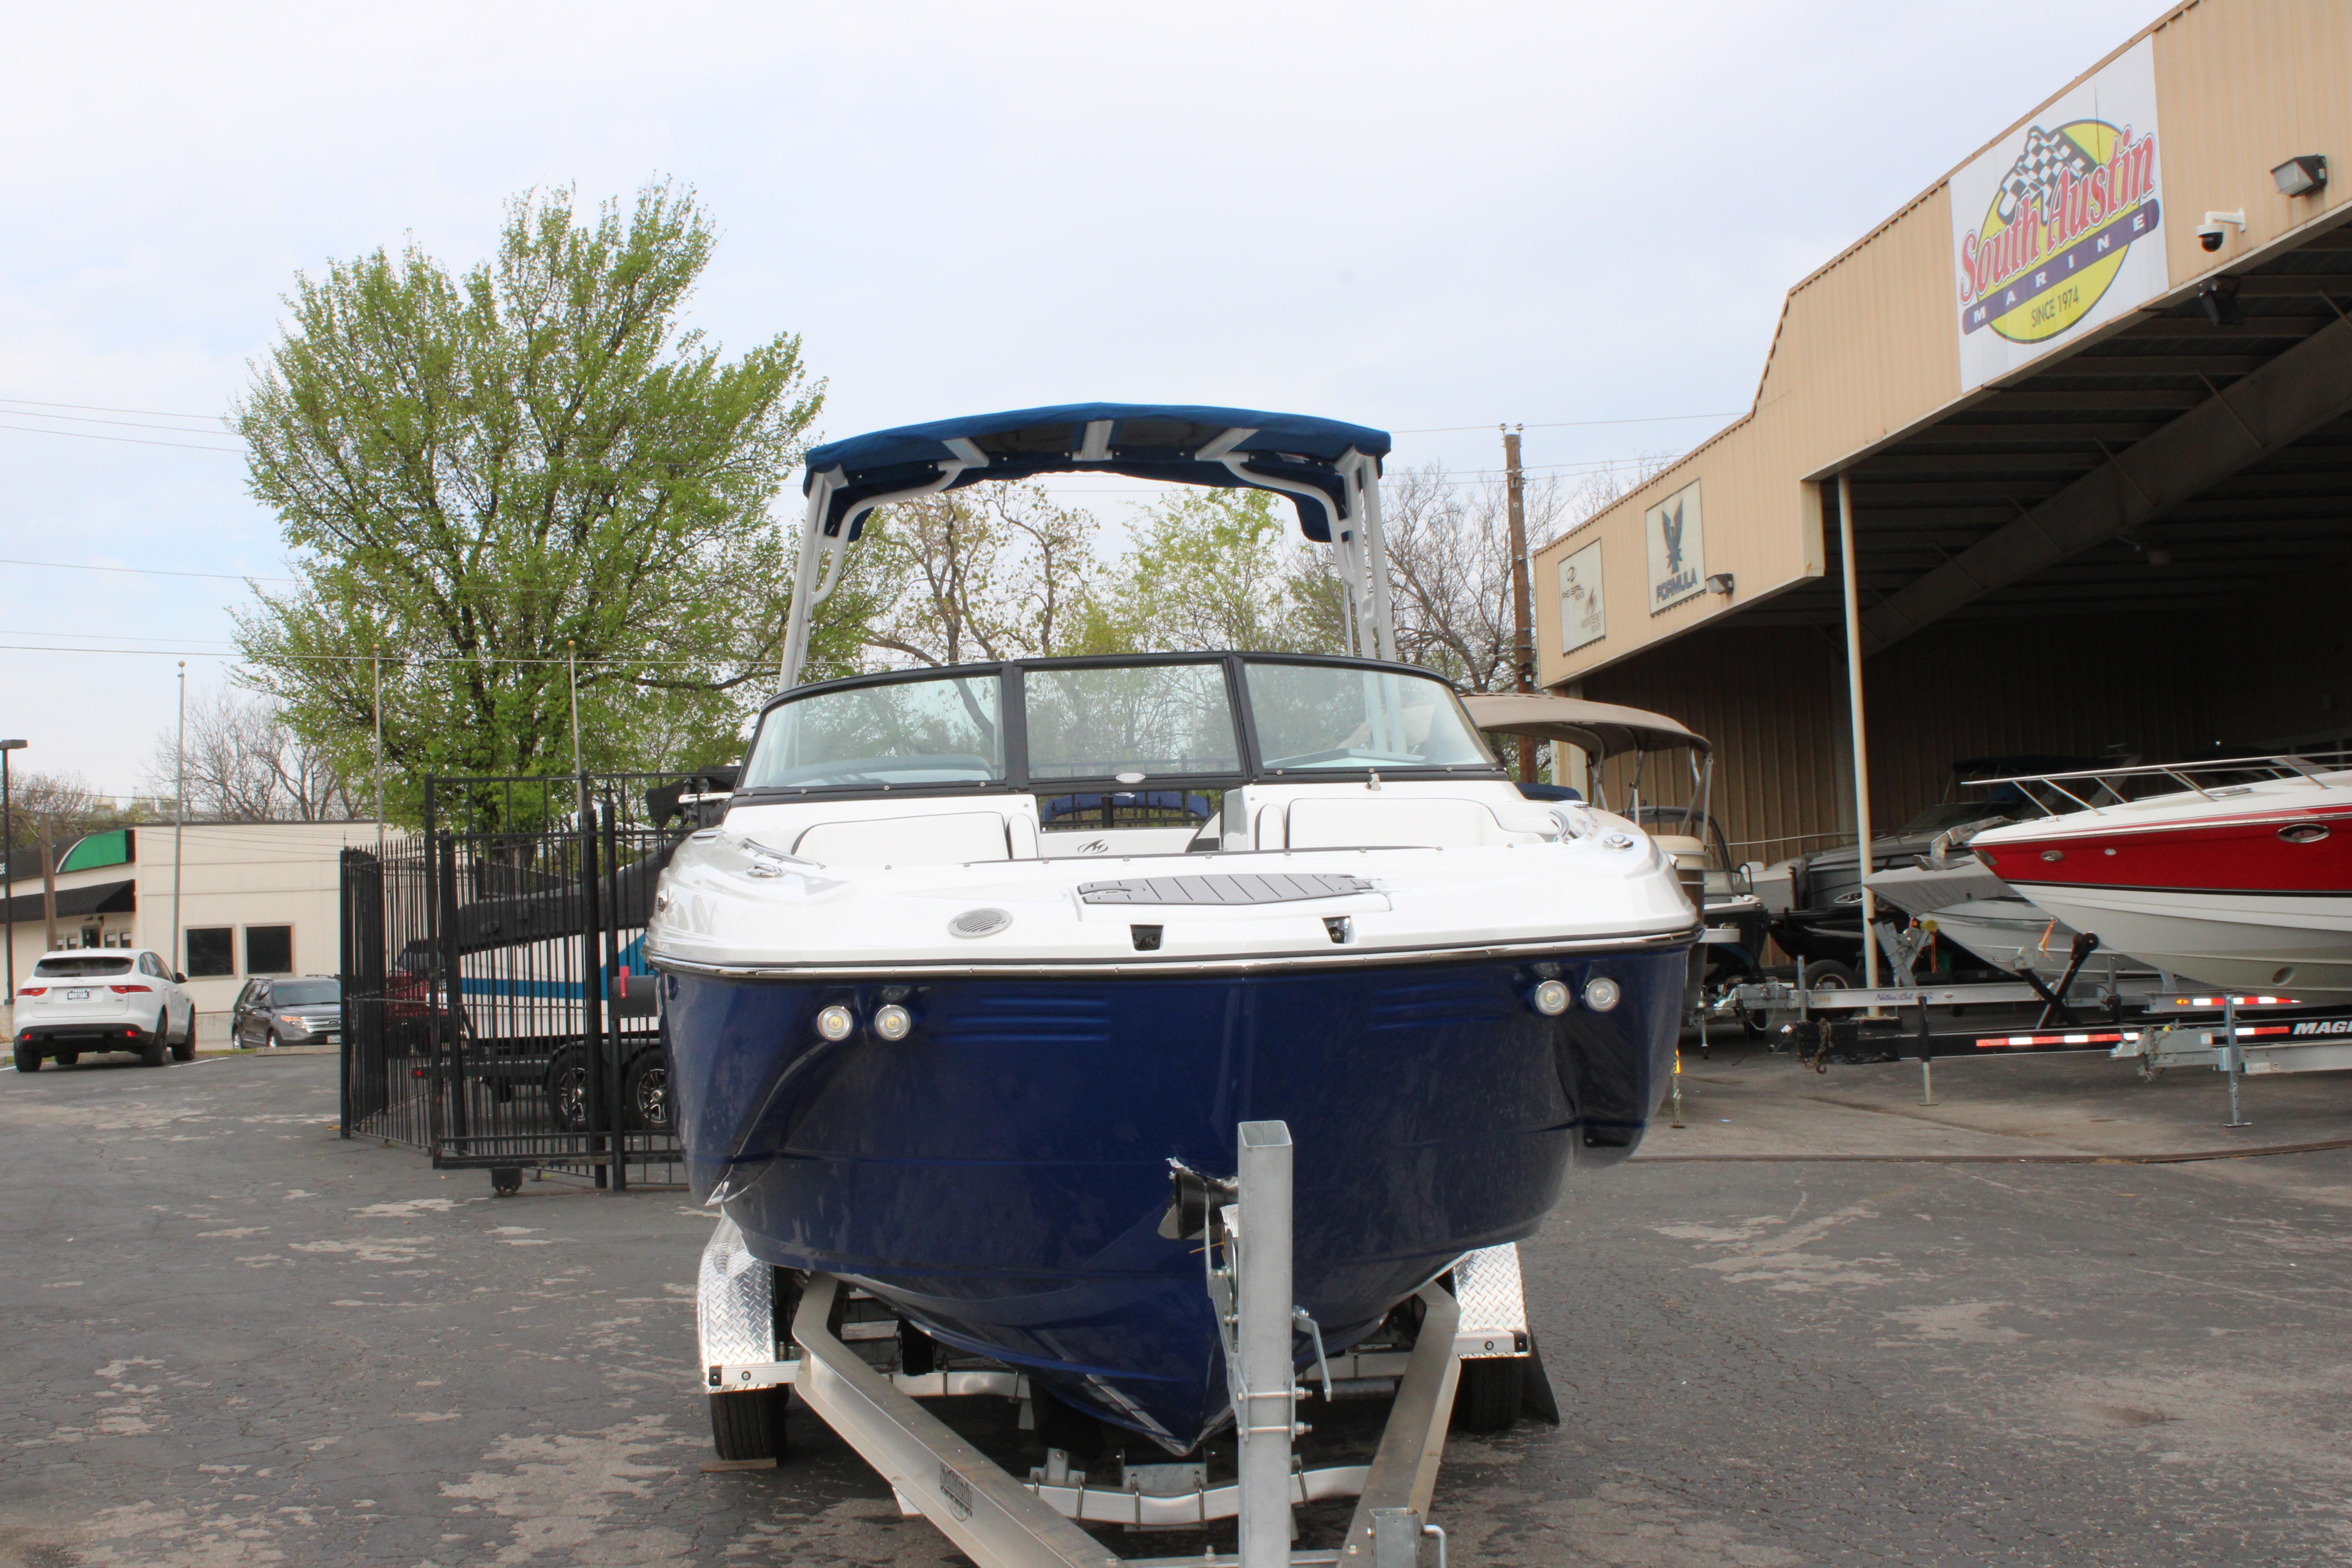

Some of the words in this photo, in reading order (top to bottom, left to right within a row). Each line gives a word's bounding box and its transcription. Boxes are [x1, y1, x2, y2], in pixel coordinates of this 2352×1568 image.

[1960, 194, 2040, 305] South
[2045, 124, 2155, 255] Austin
[1973, 213, 2146, 323] MARINE
[2032, 298, 2055, 328] SINCE
[2057, 285, 2079, 314] 1974
[1561, 584, 1584, 600] REGAL
[1656, 567, 1698, 603] FORMULA
